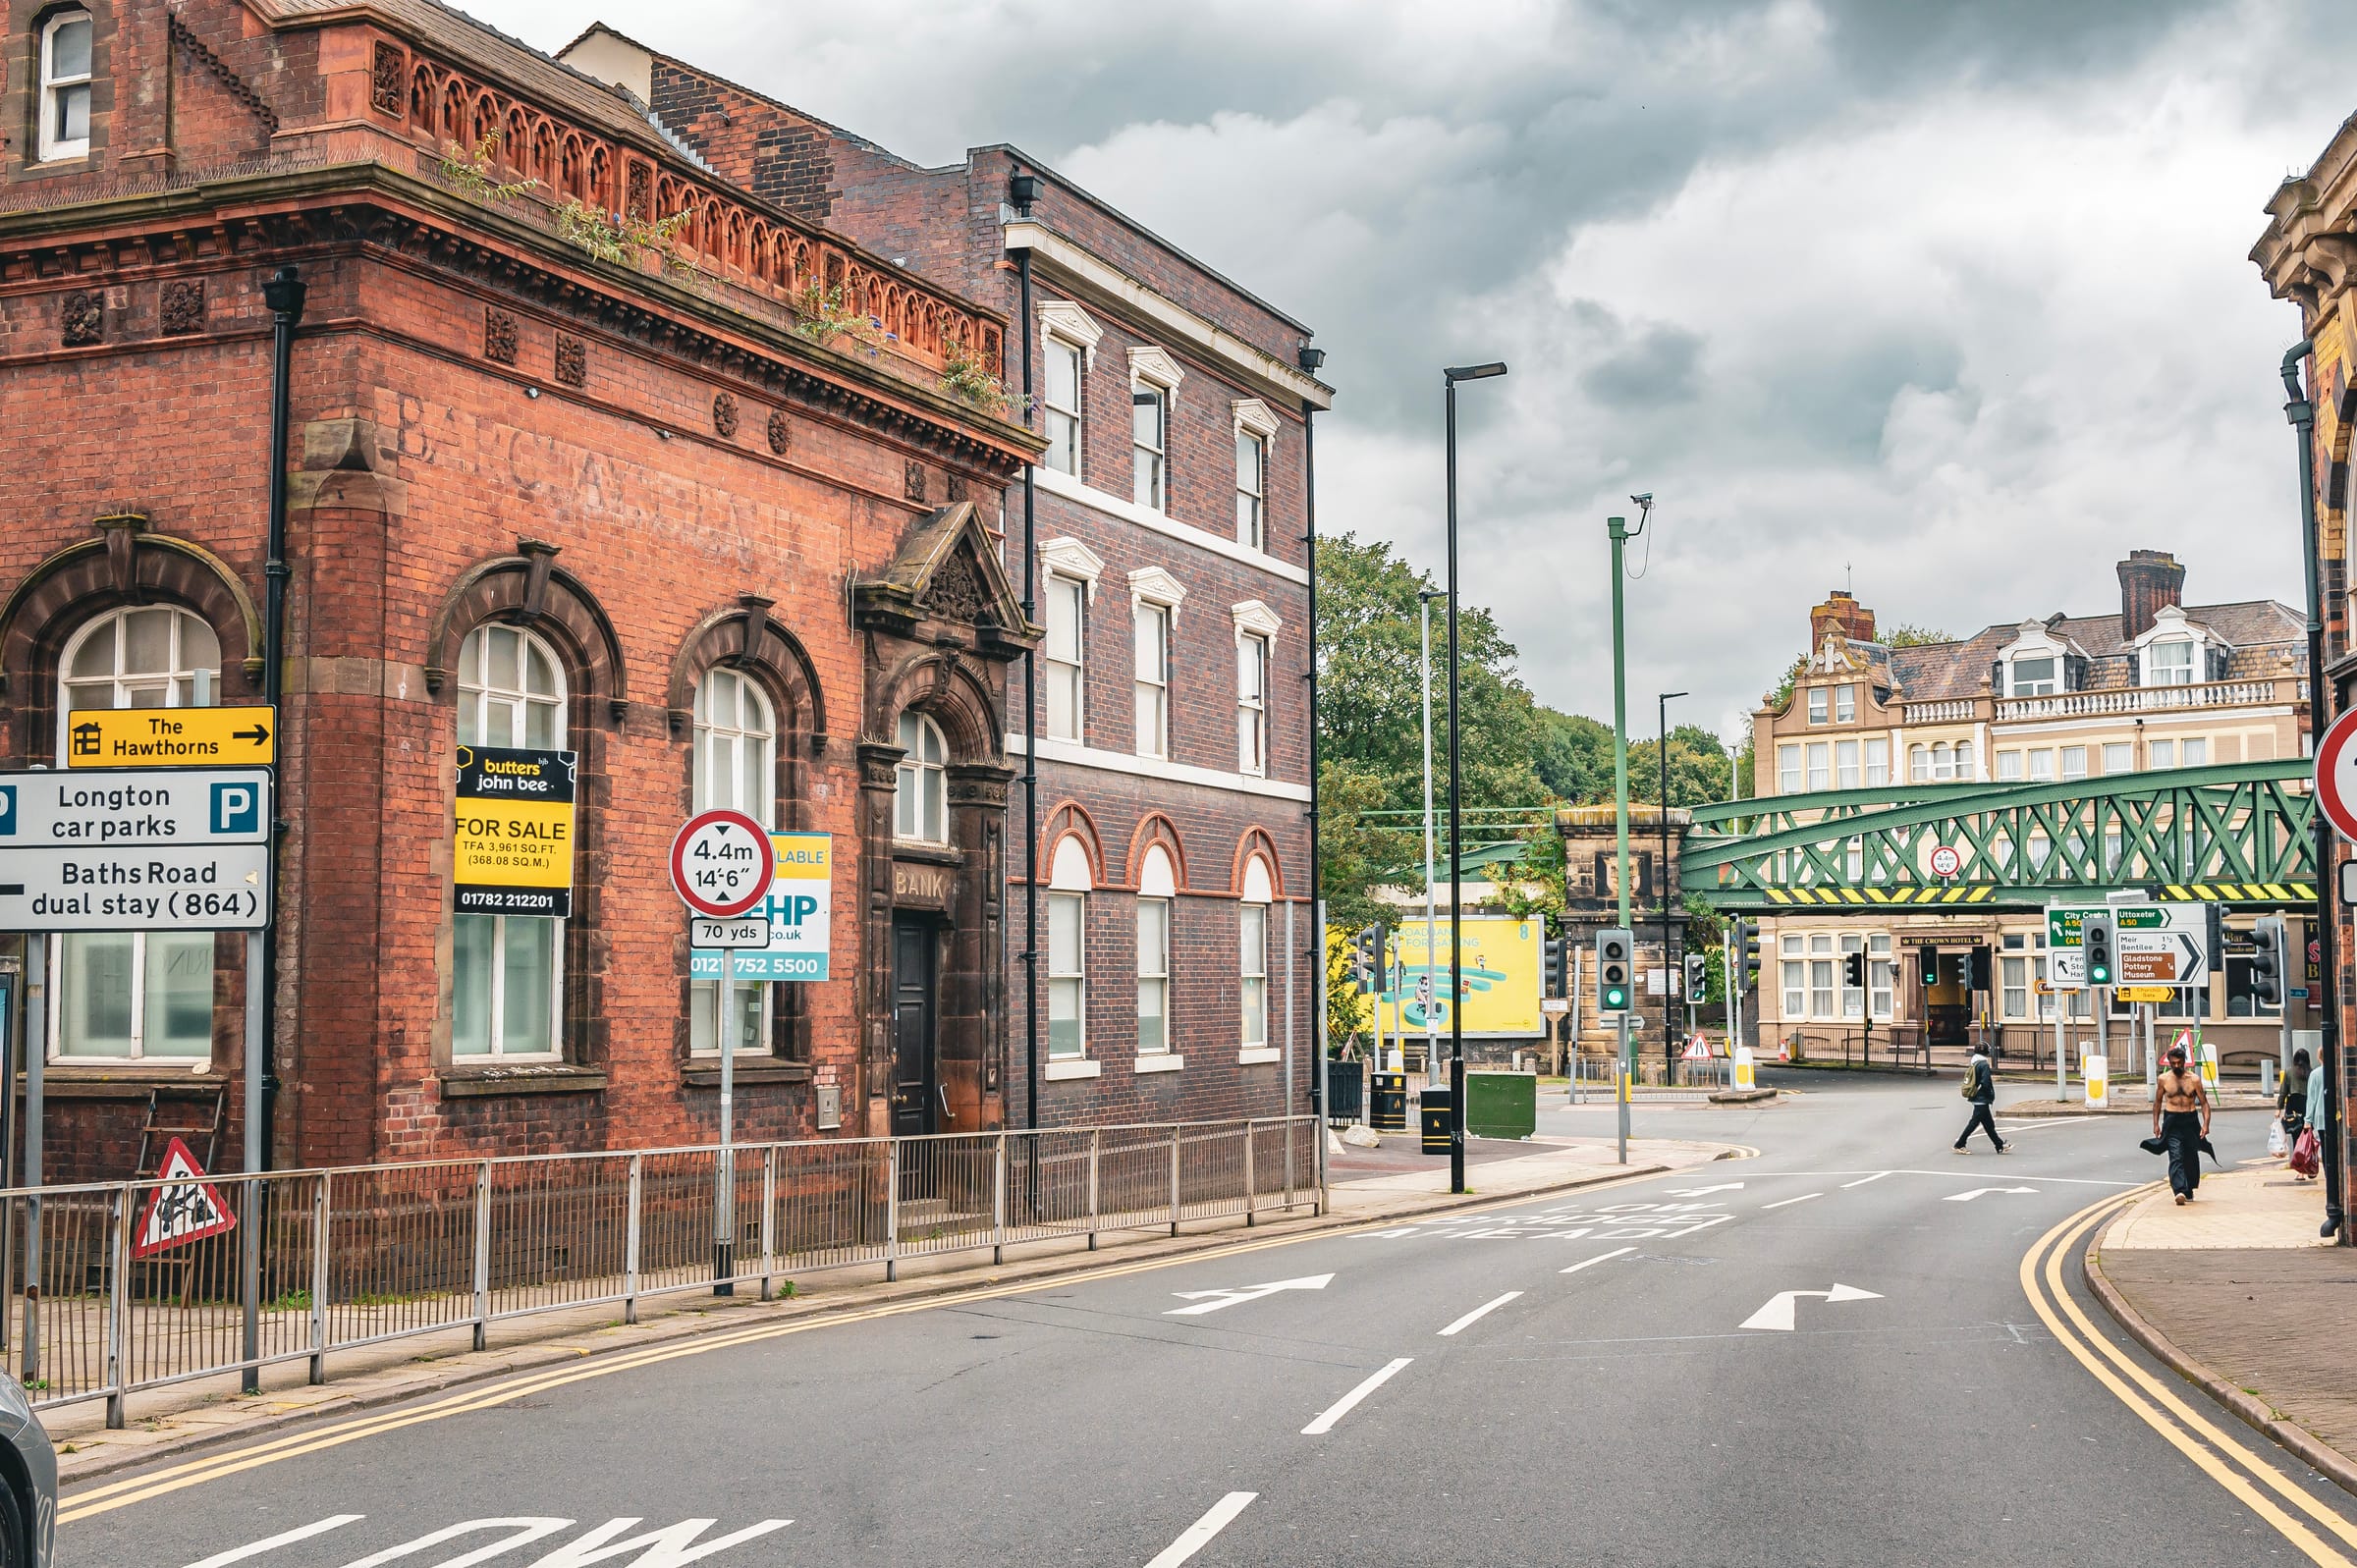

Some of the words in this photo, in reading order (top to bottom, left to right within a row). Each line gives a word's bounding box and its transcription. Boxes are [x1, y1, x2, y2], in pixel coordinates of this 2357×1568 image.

[149, 719, 183, 734] The
[114, 739, 219, 756] Hawthorns
[485, 758, 540, 776] butters
[476, 774, 513, 791] john
[518, 777, 548, 791] bee
[59, 785, 170, 811] Longton
[52, 821, 95, 838] car
[101, 815, 177, 841] parks
[456, 818, 500, 837] FOR
[508, 821, 567, 840] SALE
[463, 840, 484, 851] TFA
[488, 842, 518, 853] 3,961
[693, 839, 753, 860] 4.4m
[468, 855, 509, 866] (368.08
[776, 850, 824, 864] LABLE
[62, 862, 141, 885] Baths
[148, 861, 216, 884] Road
[896, 871, 943, 898] BANK
[31, 892, 90, 915] dual
[102, 893, 160, 919] stay
[168, 890, 257, 919] (864)
[462, 892, 503, 906] 01782
[506, 894, 554, 908] 212201
[2064, 911, 2080, 921] City
[703, 926, 723, 938] 70
[731, 926, 757, 941] yds
[735, 958, 768, 973] 752
[773, 959, 818, 973] 5500
[1540, 1203, 1728, 1213] LOW
